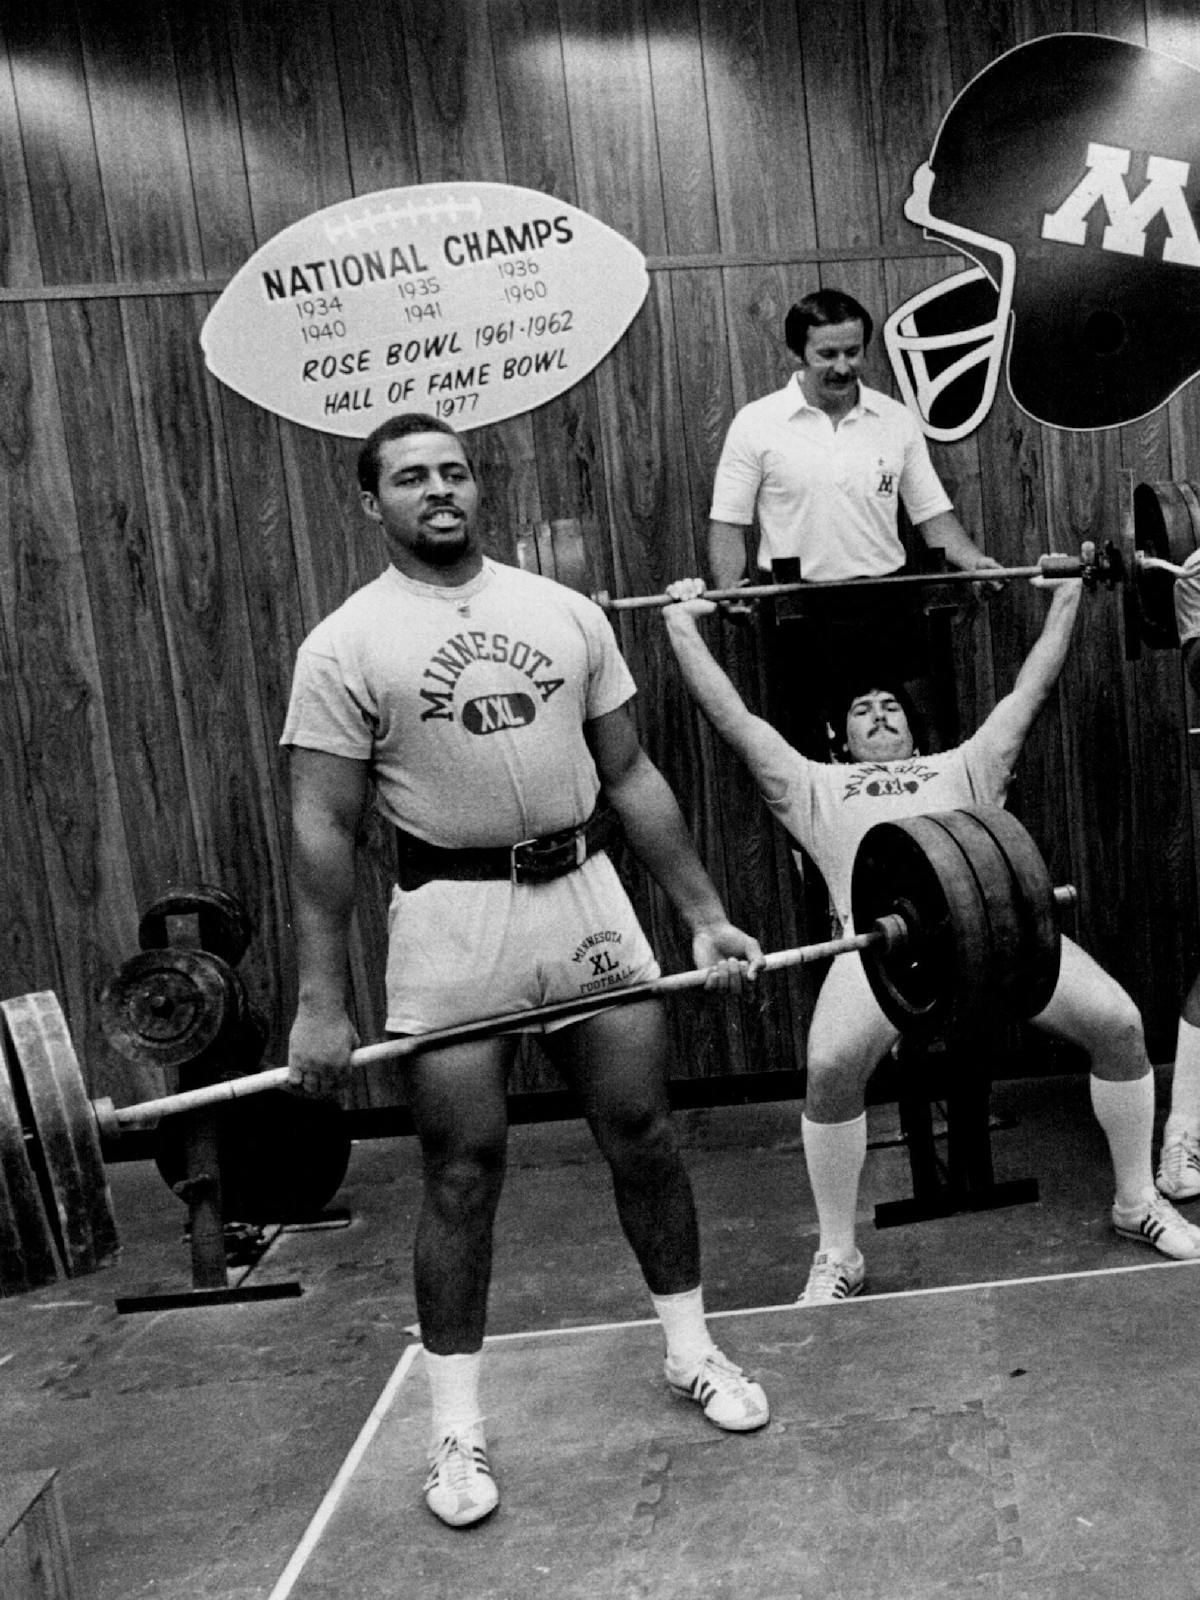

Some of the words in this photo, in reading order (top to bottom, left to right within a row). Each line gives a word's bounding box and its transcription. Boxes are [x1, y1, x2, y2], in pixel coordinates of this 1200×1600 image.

[262, 243, 428, 301] NATIONAL
[444, 216, 573, 266] CHAMPS
[296, 296, 343, 319] 1934
[398, 276, 440, 299] 1935
[498, 257, 539, 279] 1936
[302, 320, 346, 344] 1940
[405, 302, 442, 323] 1941
[504, 281, 547, 303] 1960
[302, 350, 371, 381] ROSE
[386, 331, 462, 367] BOWL
[324, 387, 373, 416] HALL
[388, 378, 415, 403] OF
[428, 363, 491, 395] FAME
[503, 348, 568, 380] BOWL
[435, 393, 479, 418] 1977
[419, 631, 565, 722] MINNESOTA
[473, 696, 526, 732] XXL
[843, 764, 939, 801] MINNSOTA
[572, 930, 622, 963] MINNESOTA
[589, 951, 620, 976] XL
[580, 966, 635, 993] FOOTBALL
